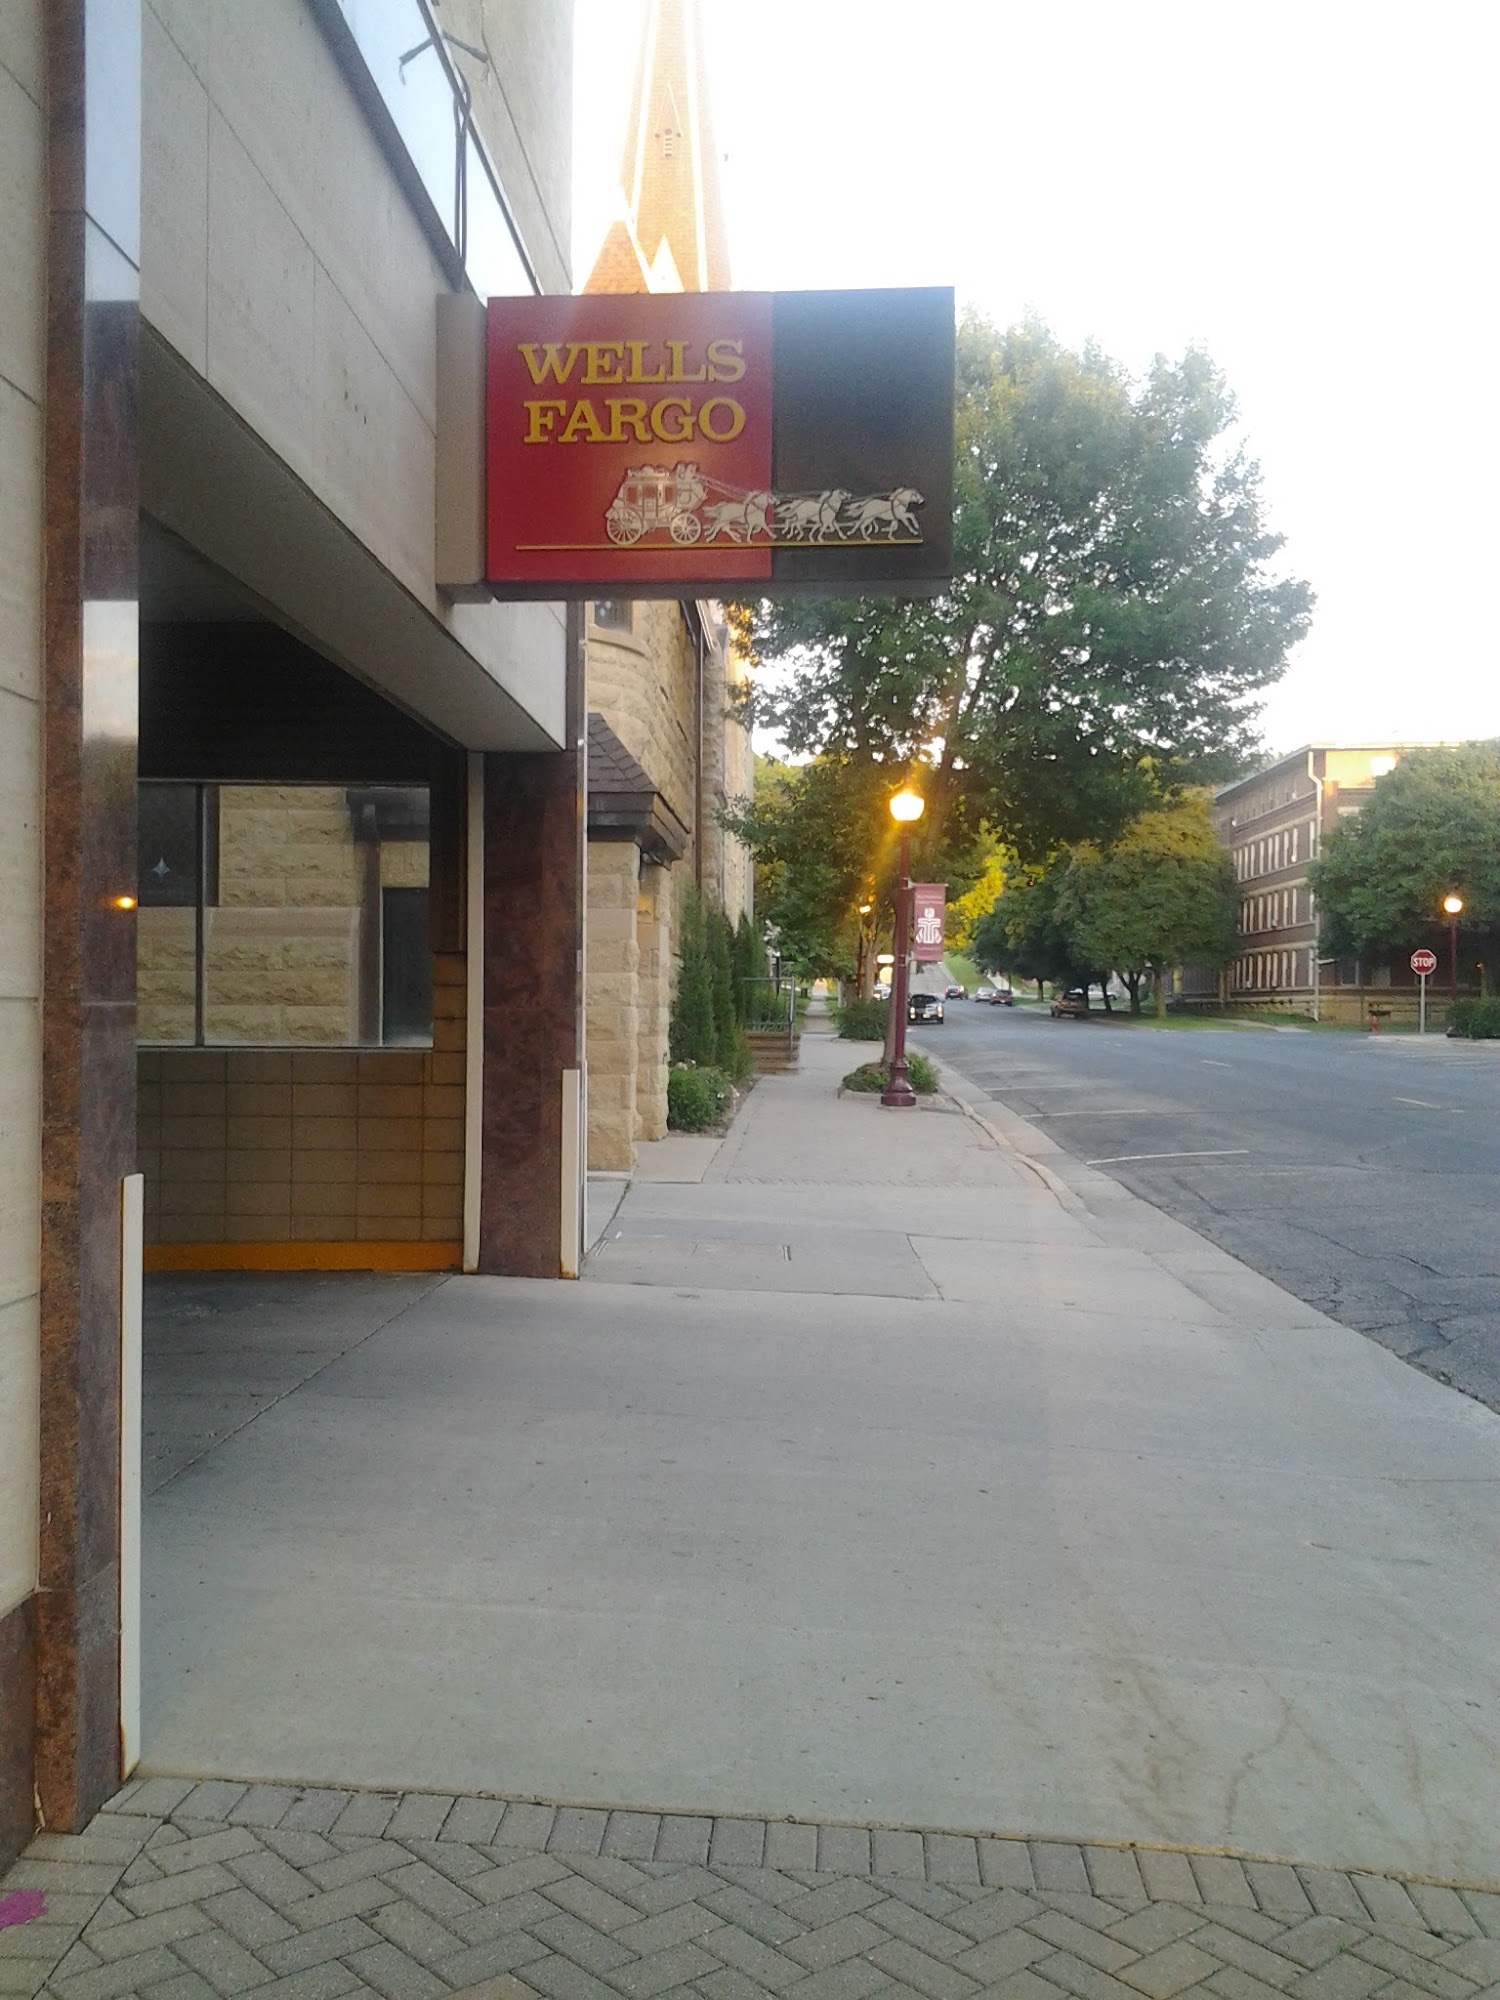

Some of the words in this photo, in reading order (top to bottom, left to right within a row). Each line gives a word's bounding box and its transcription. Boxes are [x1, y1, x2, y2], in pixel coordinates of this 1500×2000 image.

[517, 339, 746, 385] WELLS
[523, 397, 746, 444] FARGO
[1413, 957, 1434, 967] STOP
